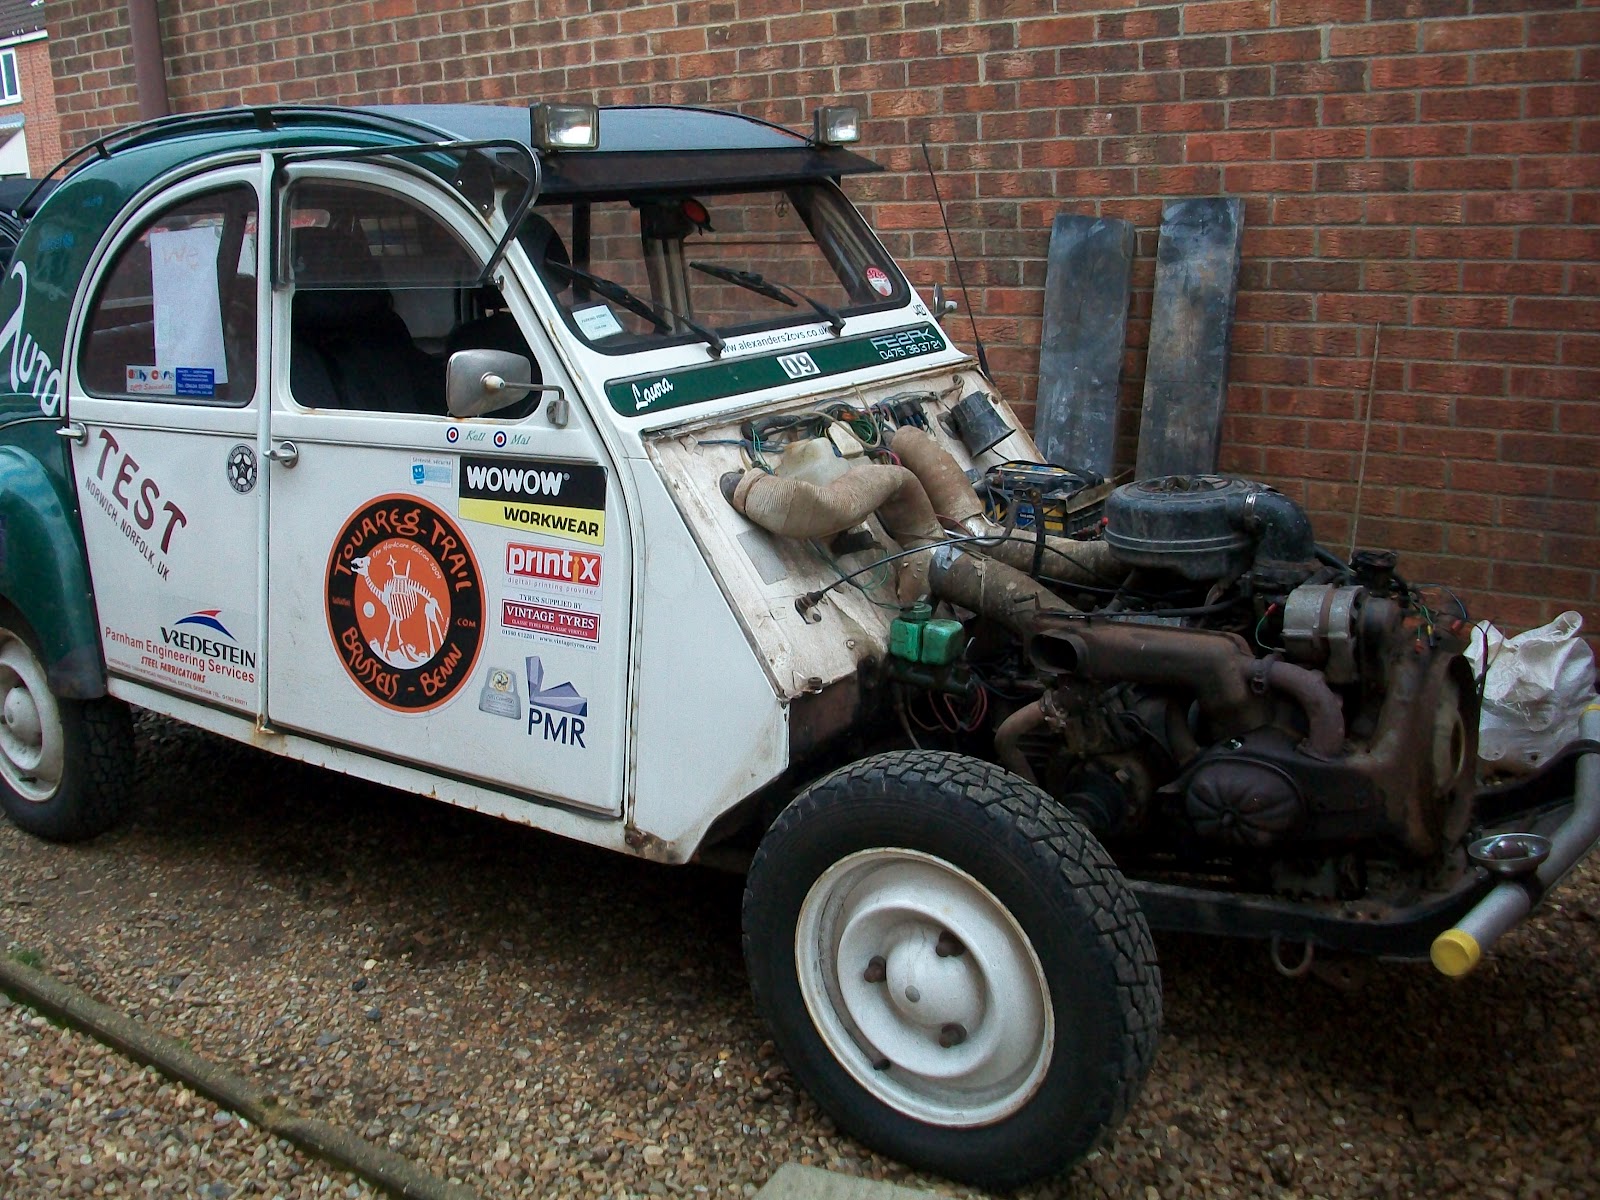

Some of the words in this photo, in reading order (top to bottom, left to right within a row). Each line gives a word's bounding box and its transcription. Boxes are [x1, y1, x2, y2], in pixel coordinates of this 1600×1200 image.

[722, 325, 828, 353] ww.alexanders2cvs.co.uk
[781, 355, 816, 376] 09
[879, 348, 906, 360] 0475
[96, 428, 187, 554] TEST
[466, 465, 563, 496] WOWOW
[85, 476, 118, 526] NORWICH,
[158, 563, 170, 580] UK
[504, 506, 600, 537] WORKWEAR
[508, 577, 532, 587] digital
[534, 580, 562, 592] printing
[566, 586, 597, 596] provider
[520, 594, 540, 602] TYRES
[506, 605, 554, 623] VINTAGE
[558, 614, 596, 630] TYRES
[105, 626, 144, 650] Parnham
[146, 640, 205, 672] Engineering
[208, 659, 255, 683] Services
[160, 626, 256, 668] VREDESTEIN
[141, 656, 158, 669] STEEL
[160, 662, 206, 684] FABRICATIONS
[528, 708, 586, 748] PMR
